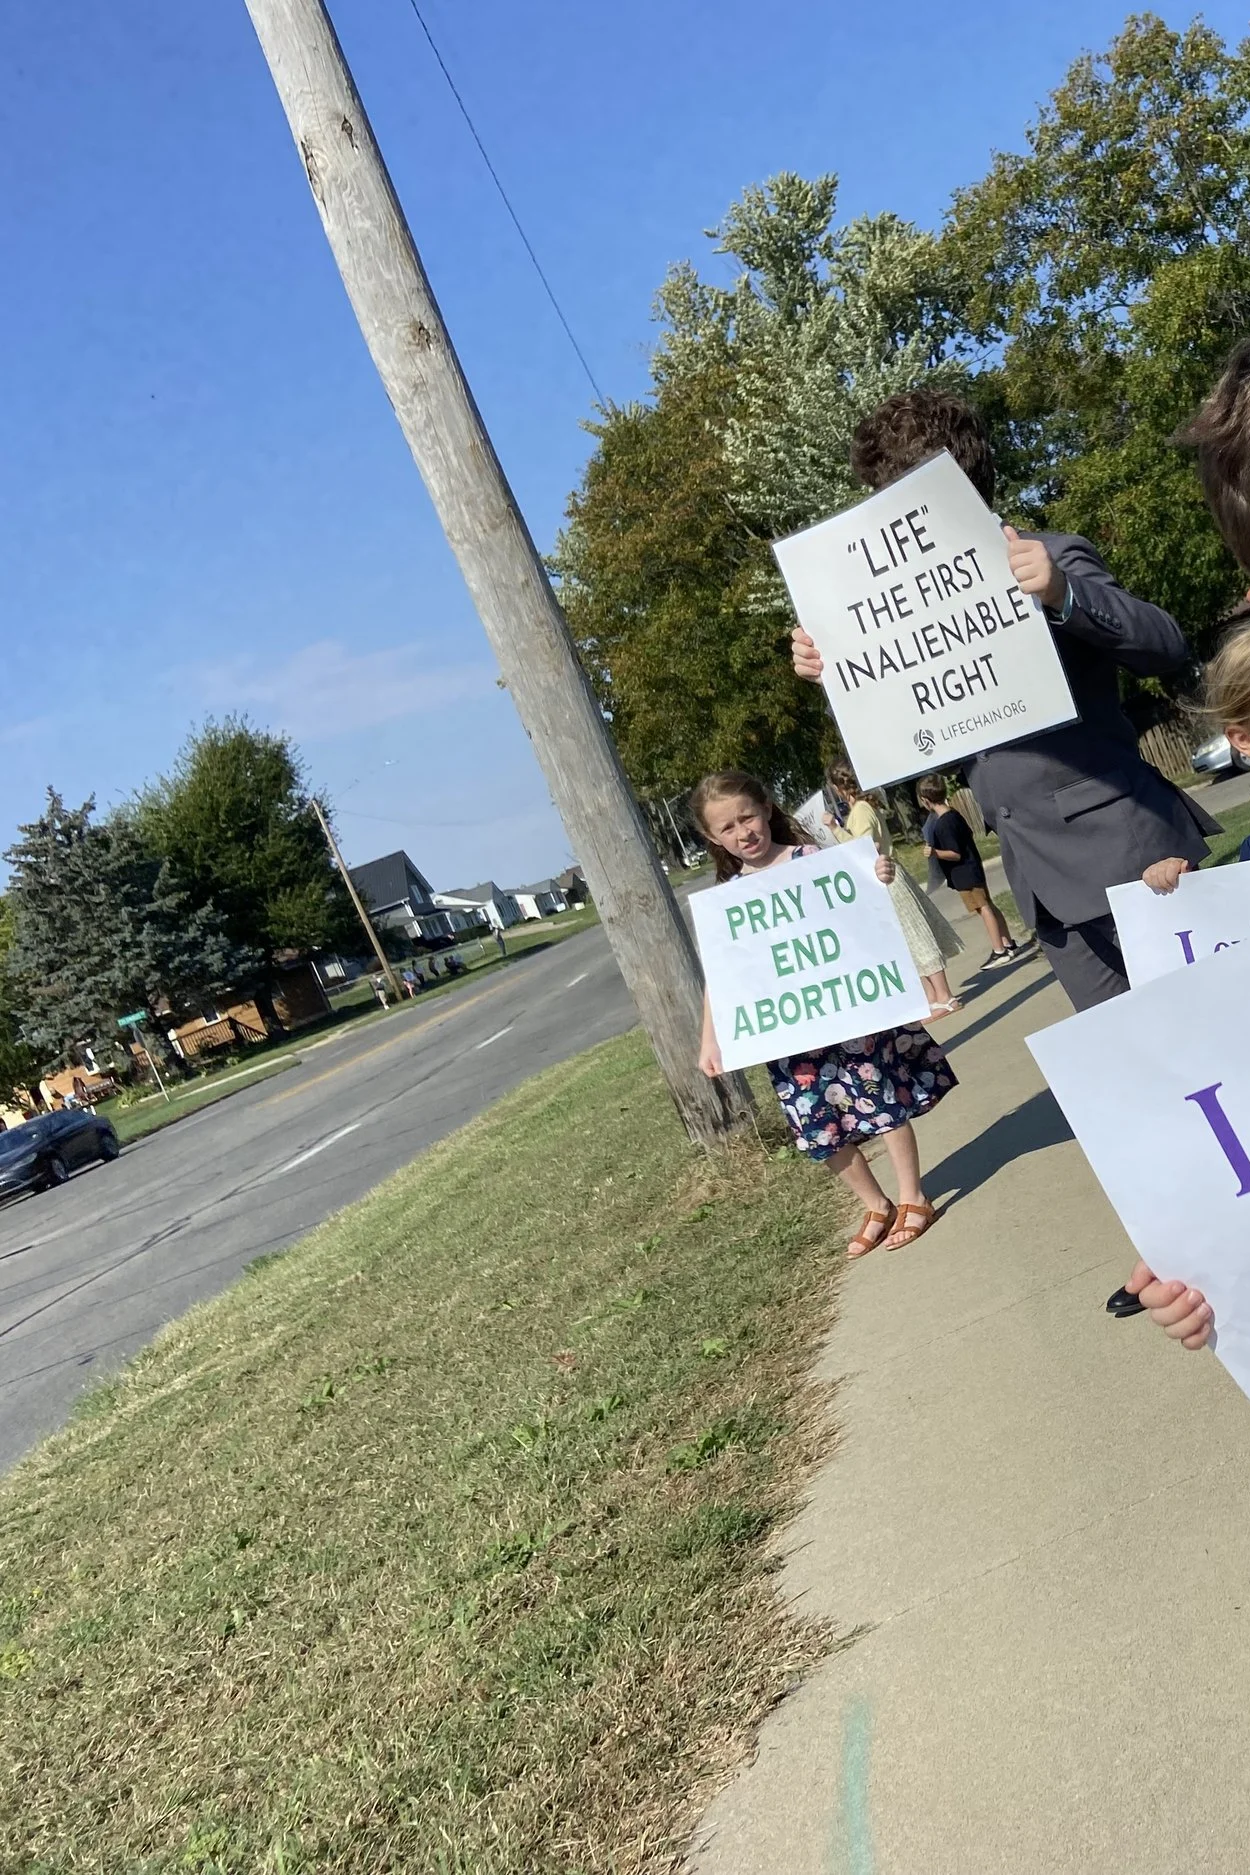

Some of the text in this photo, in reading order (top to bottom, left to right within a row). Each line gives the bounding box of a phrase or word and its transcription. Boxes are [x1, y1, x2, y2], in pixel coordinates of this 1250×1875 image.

[847, 547, 985, 635] THE FIRST
[835, 585, 1031, 693] INALIENABLE
[911, 653, 999, 715] RIGHT
[940, 699, 1027, 741] LIFECHAIN.ORG
[725, 870, 857, 941] PRAY TO
[770, 928, 841, 978] END
[733, 960, 907, 1041] ABORTION
